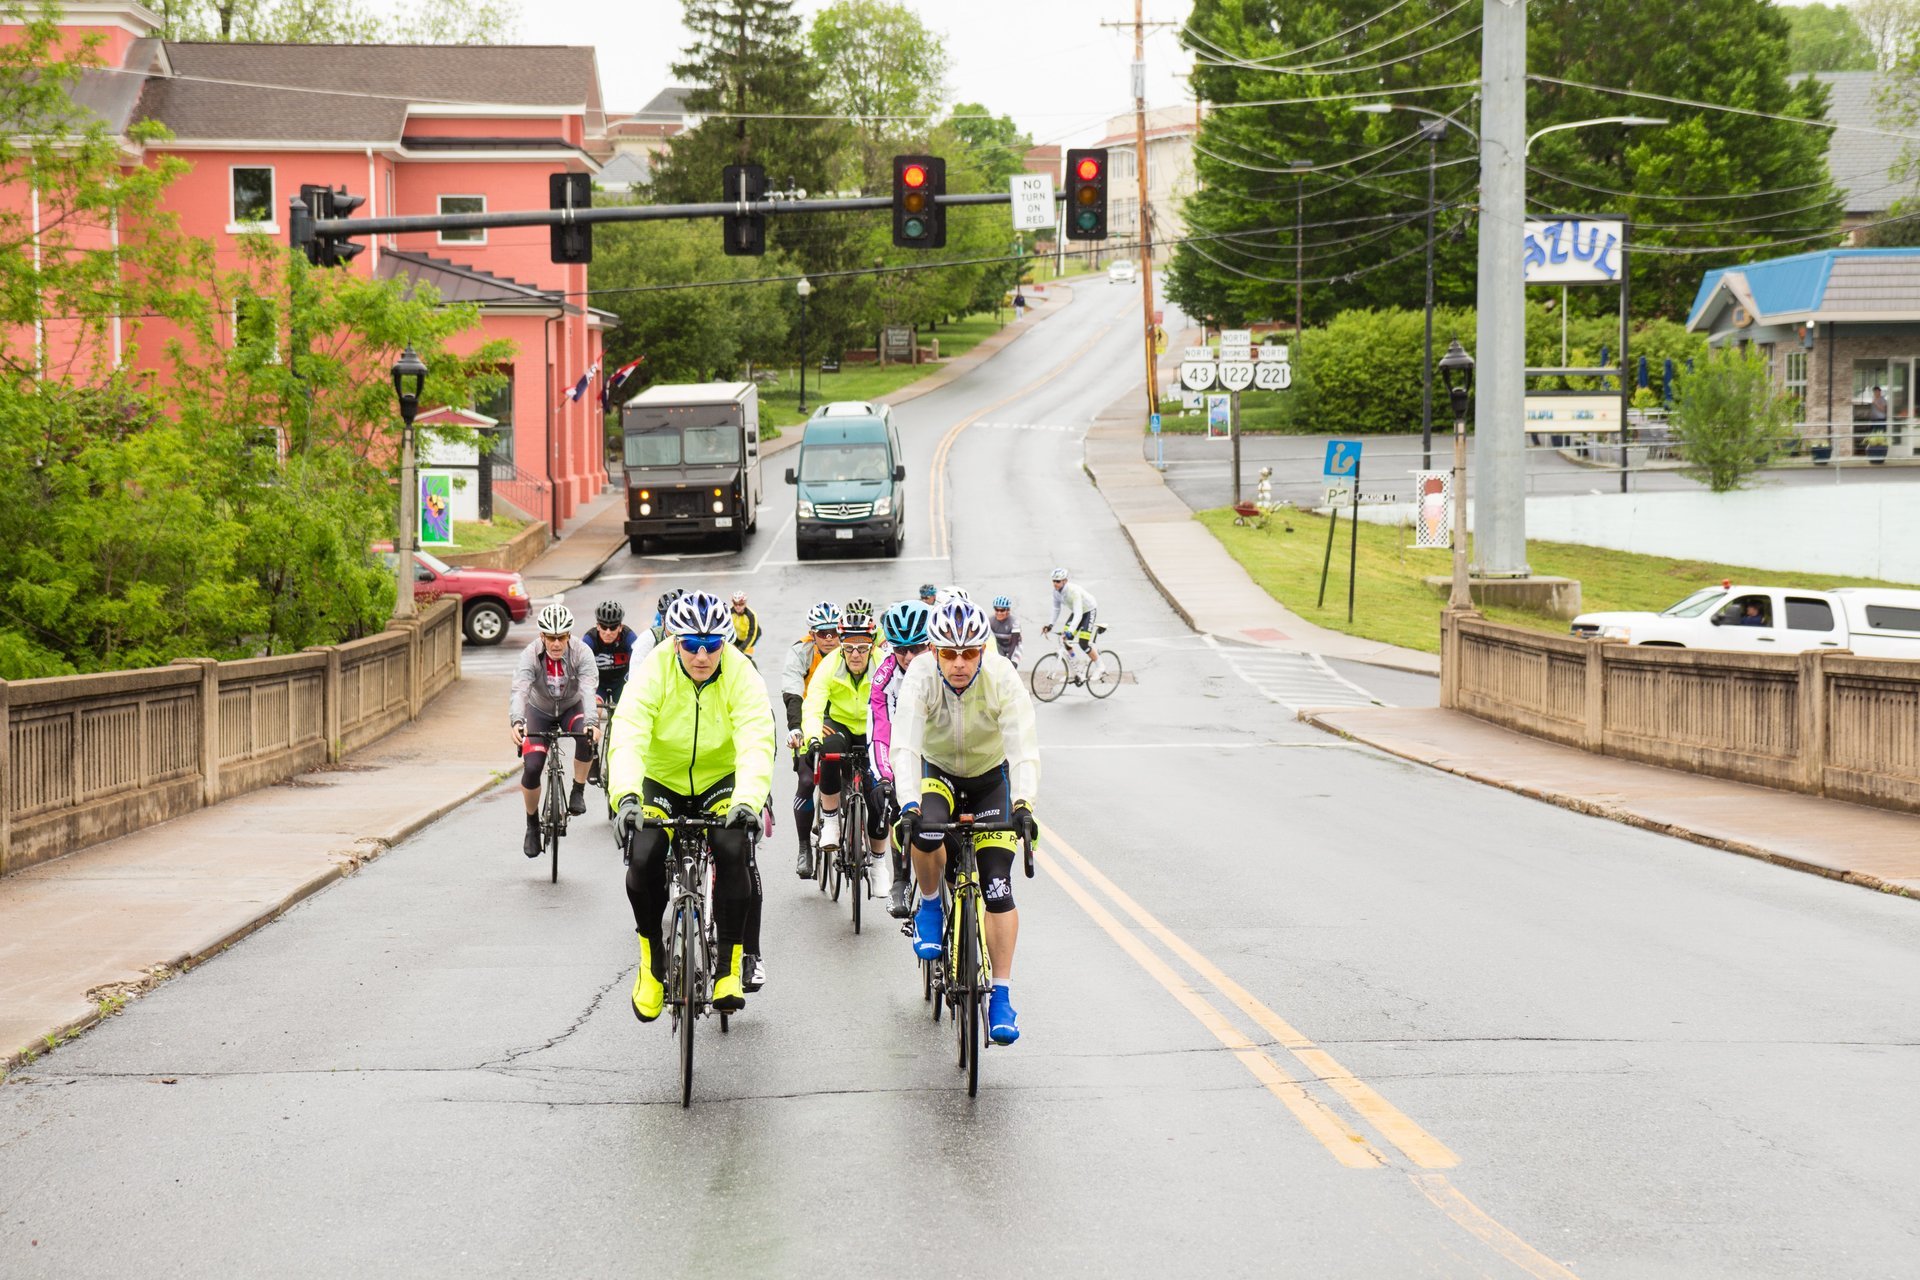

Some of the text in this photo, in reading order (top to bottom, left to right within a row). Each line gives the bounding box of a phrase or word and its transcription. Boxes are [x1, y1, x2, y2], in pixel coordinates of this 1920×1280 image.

[1024, 180, 1041, 189] NO
[1022, 193, 1045, 201] TURN
[1028, 205, 1040, 213] ON
[1027, 216, 1044, 224] RED
[1524, 220, 1617, 279] AZUL
[1185, 348, 1211, 356] NORTH
[1261, 348, 1287, 356] NORTH
[1189, 367, 1209, 383] 43
[1223, 367, 1249, 383] 122
[1262, 368, 1286, 384] 221
[1327, 489, 1338, 504] P
